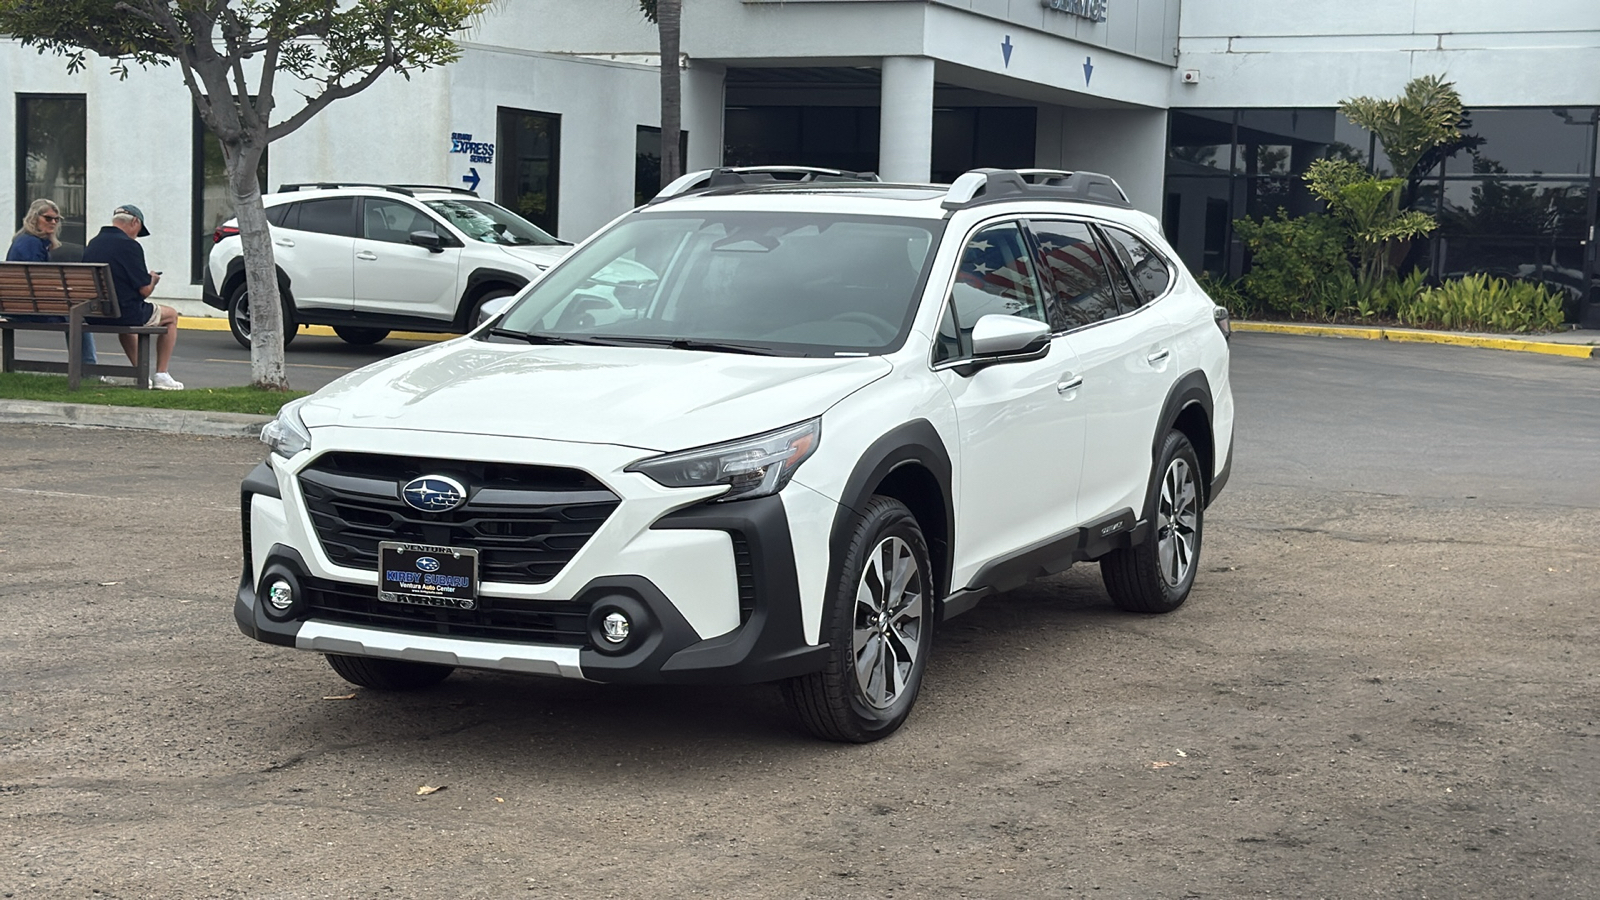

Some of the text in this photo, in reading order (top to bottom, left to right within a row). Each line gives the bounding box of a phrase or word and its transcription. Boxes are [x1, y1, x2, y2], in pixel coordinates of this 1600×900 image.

[451, 132, 472, 141] SUBARU
[450, 139, 494, 156] EXPRESS
[470, 155, 493, 164] SERVICE
[403, 545, 453, 554] VENTURA
[387, 570, 469, 587] KIRBY SUBARU
[400, 582, 421, 590] Ventura
[436, 585, 456, 593] Center
[397, 594, 458, 607] KIRBY
